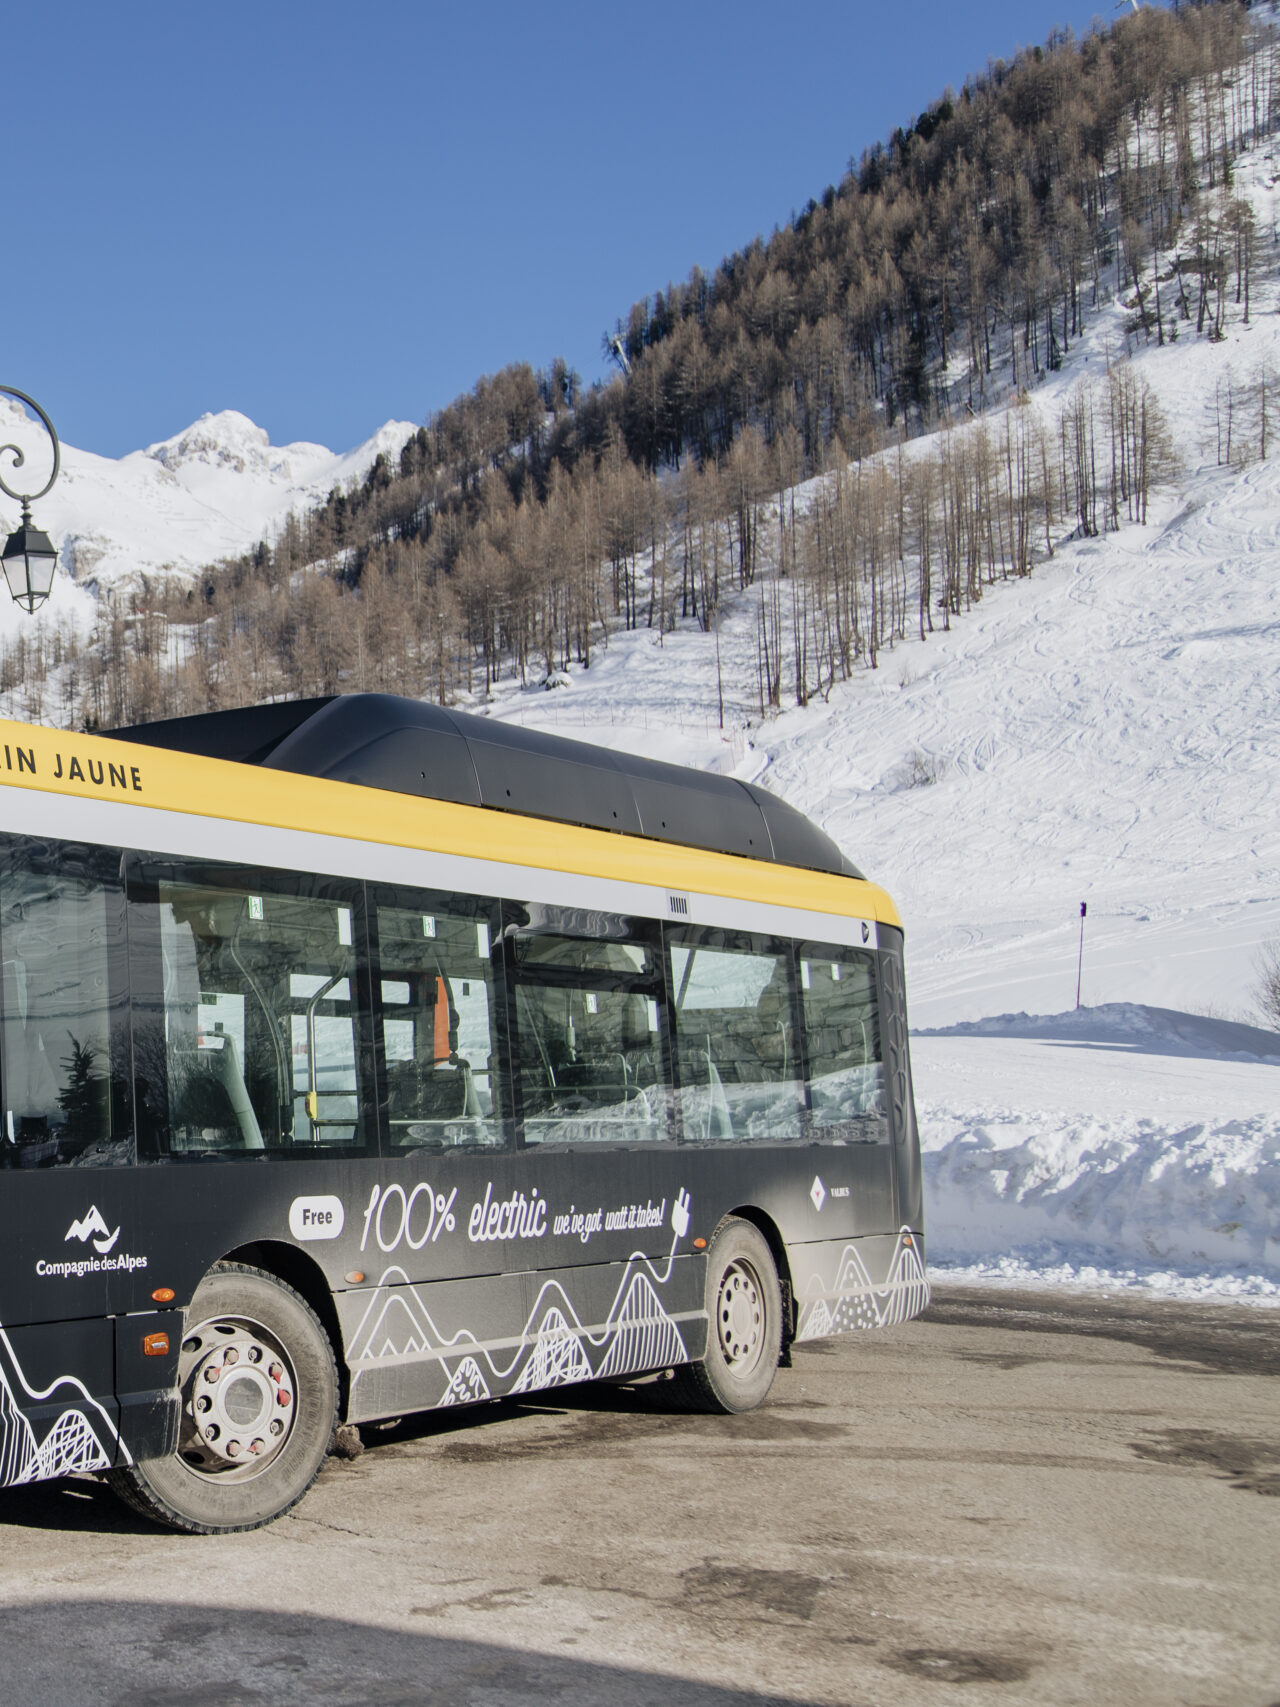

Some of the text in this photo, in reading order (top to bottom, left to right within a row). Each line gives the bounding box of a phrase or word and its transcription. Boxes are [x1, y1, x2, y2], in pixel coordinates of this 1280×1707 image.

[54, 754, 143, 791] JAUNE
[302, 1208, 333, 1226] Free
[360, 1182, 458, 1252] 100%
[468, 1181, 547, 1242] electric
